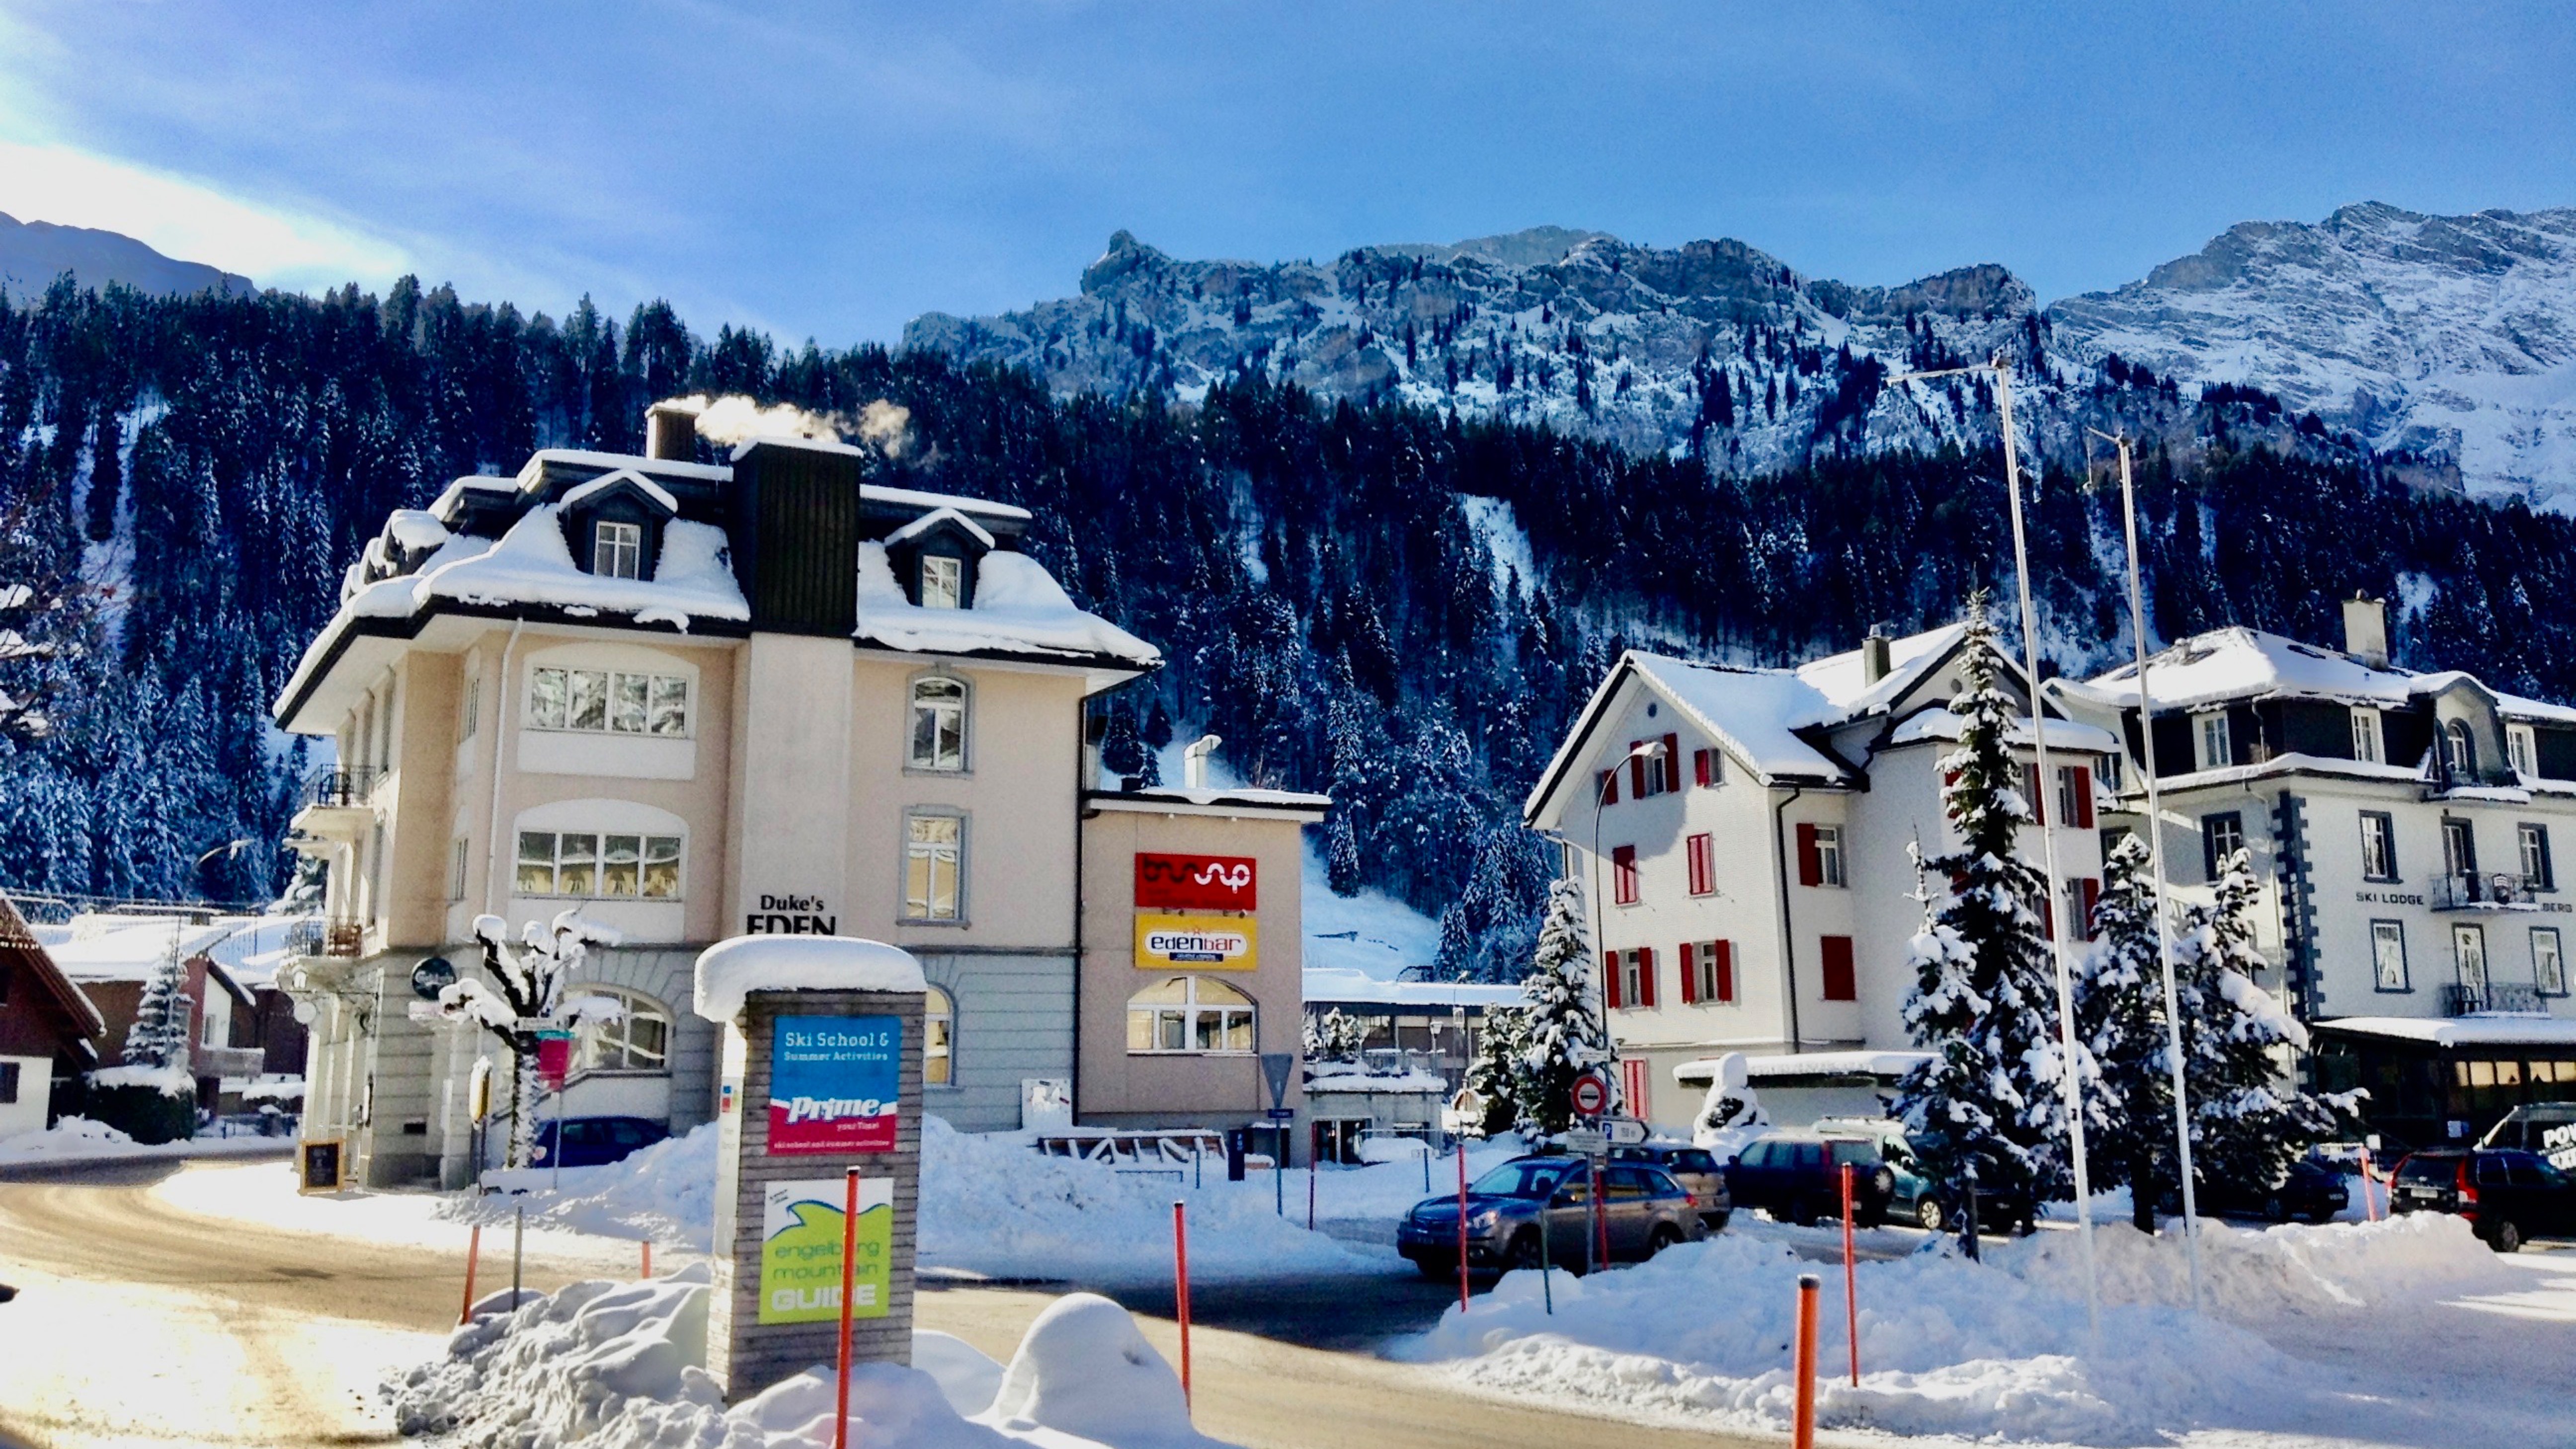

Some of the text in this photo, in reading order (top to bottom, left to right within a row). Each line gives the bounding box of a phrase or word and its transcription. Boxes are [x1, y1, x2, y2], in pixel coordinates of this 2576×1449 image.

[760, 894, 824, 911] Duke's
[2356, 892, 2377, 902] SKI
[2382, 894, 2424, 905] LODGE
[785, 1032, 889, 1047] Ski School &
[784, 1051, 888, 1061] Summer Activities
[775, 1241, 880, 1261] engelbrg
